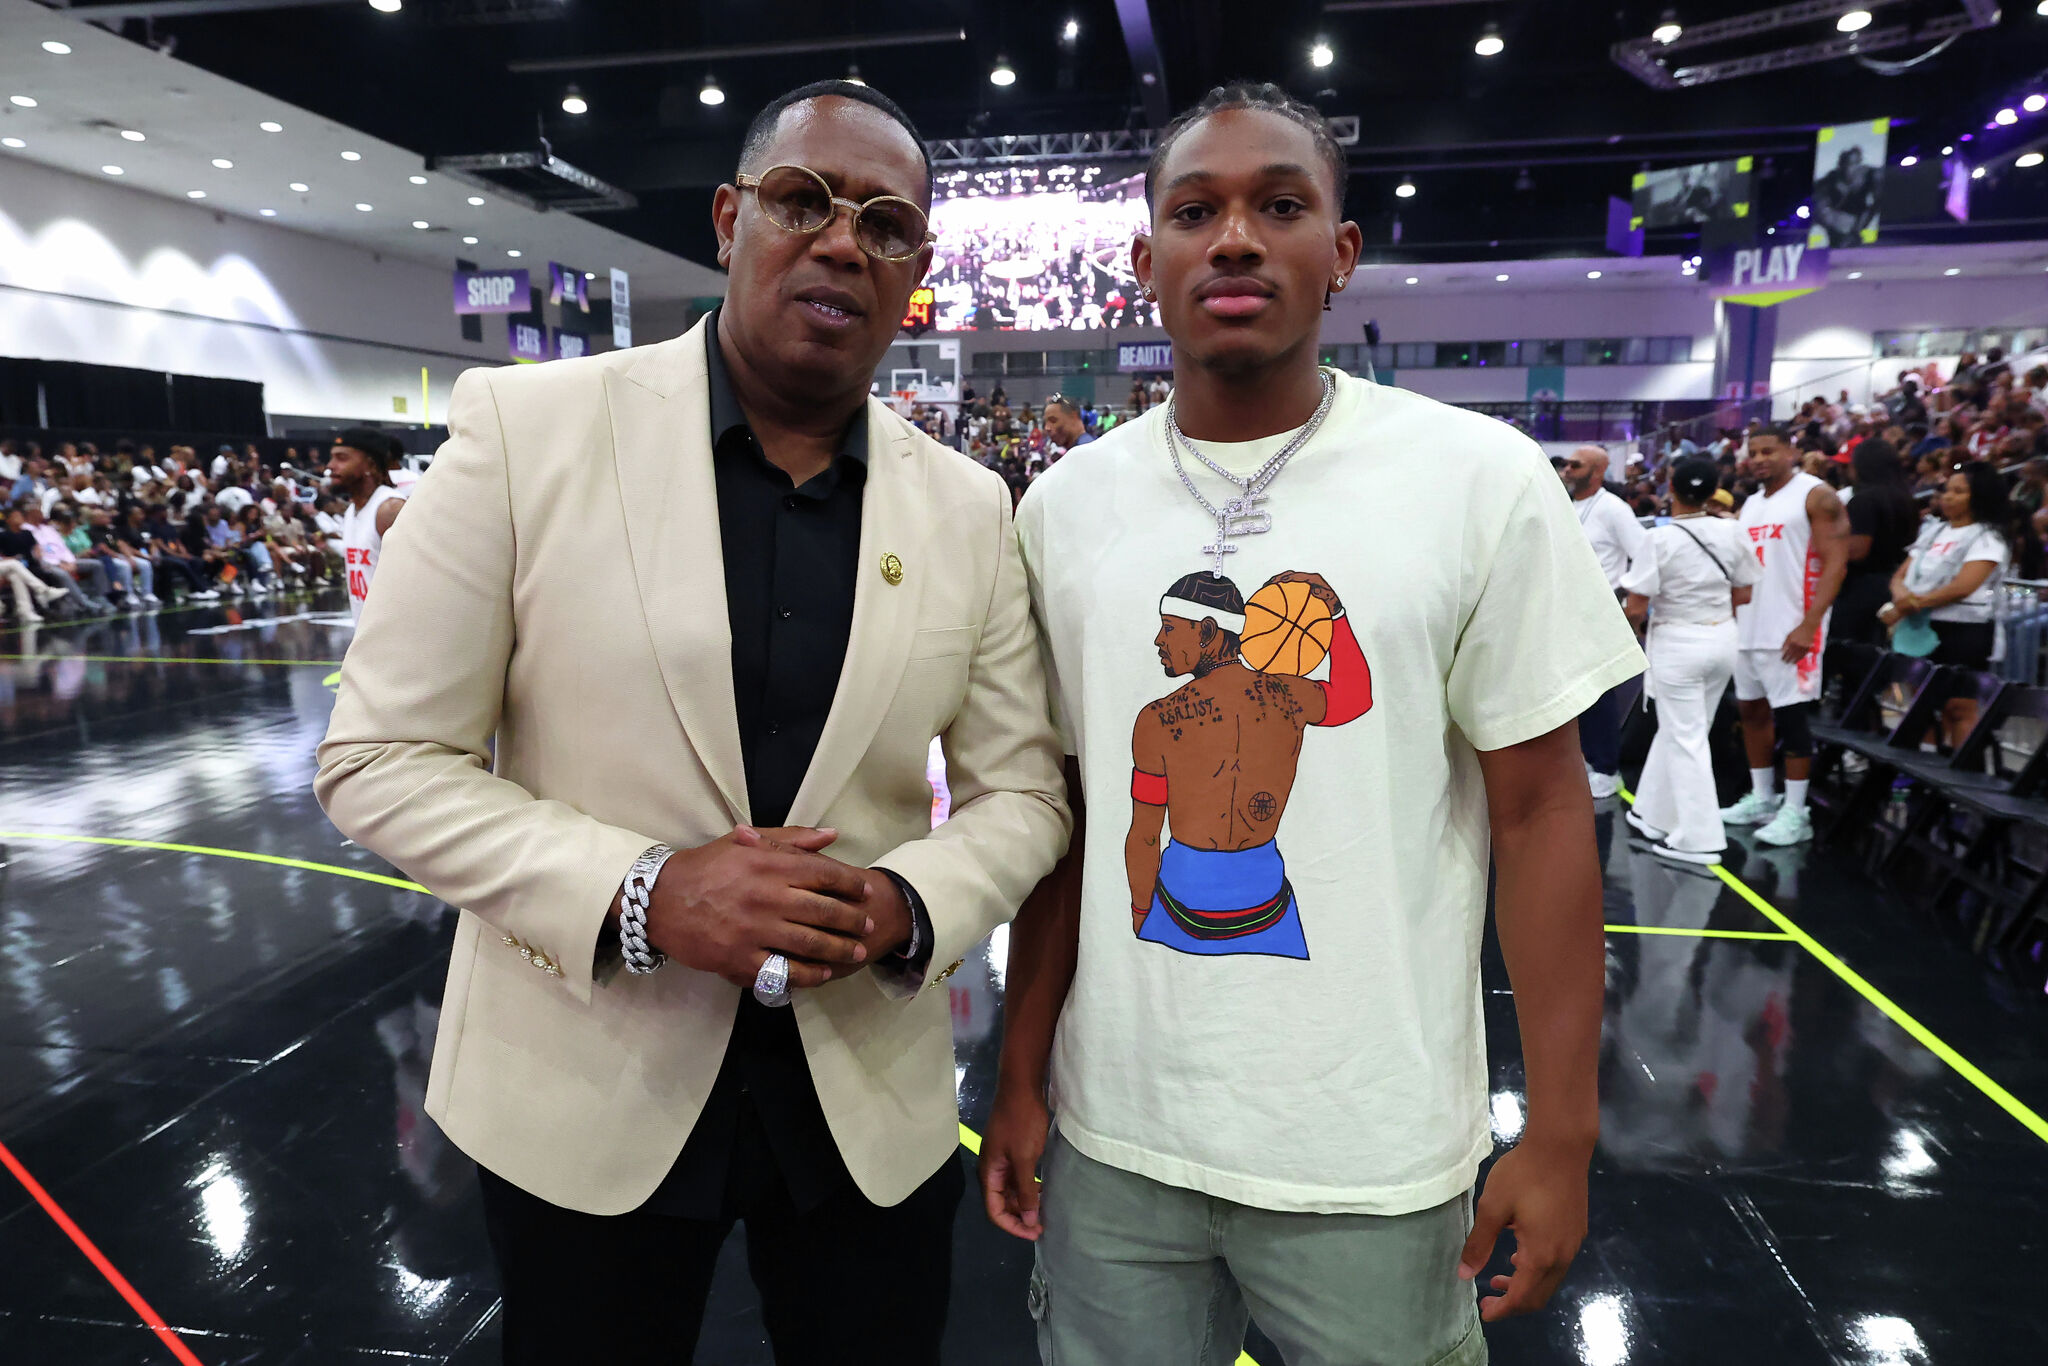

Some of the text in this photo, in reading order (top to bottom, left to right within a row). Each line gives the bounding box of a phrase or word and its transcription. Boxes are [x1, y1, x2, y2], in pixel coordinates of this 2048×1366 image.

[1733, 243, 1804, 286] PLAY
[467, 276, 515, 307] SHOP
[1119, 345, 1172, 367] BEAUTY
[1158, 697, 1215, 727] REALIST
